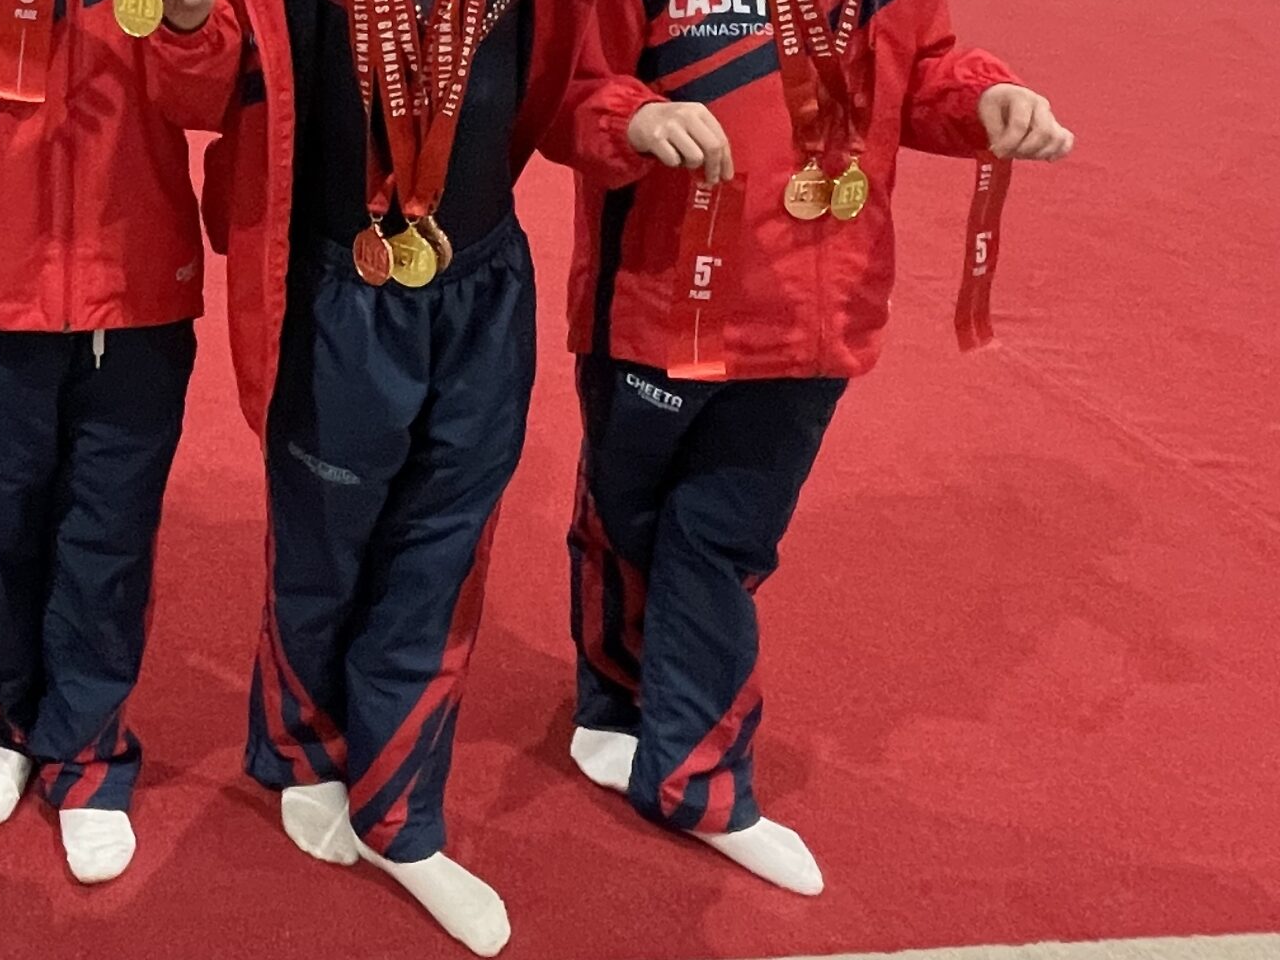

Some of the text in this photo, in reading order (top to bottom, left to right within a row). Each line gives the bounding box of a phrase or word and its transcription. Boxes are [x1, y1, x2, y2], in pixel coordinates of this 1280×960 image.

[669, 22, 775, 38] GYMNASTICS
[809, 26, 832, 58] JETS
[835, 21, 853, 54] JETS
[377, 20, 407, 117] GYMNASTICS
[442, 83, 463, 117] JETS
[625, 373, 683, 408] CHEETA
